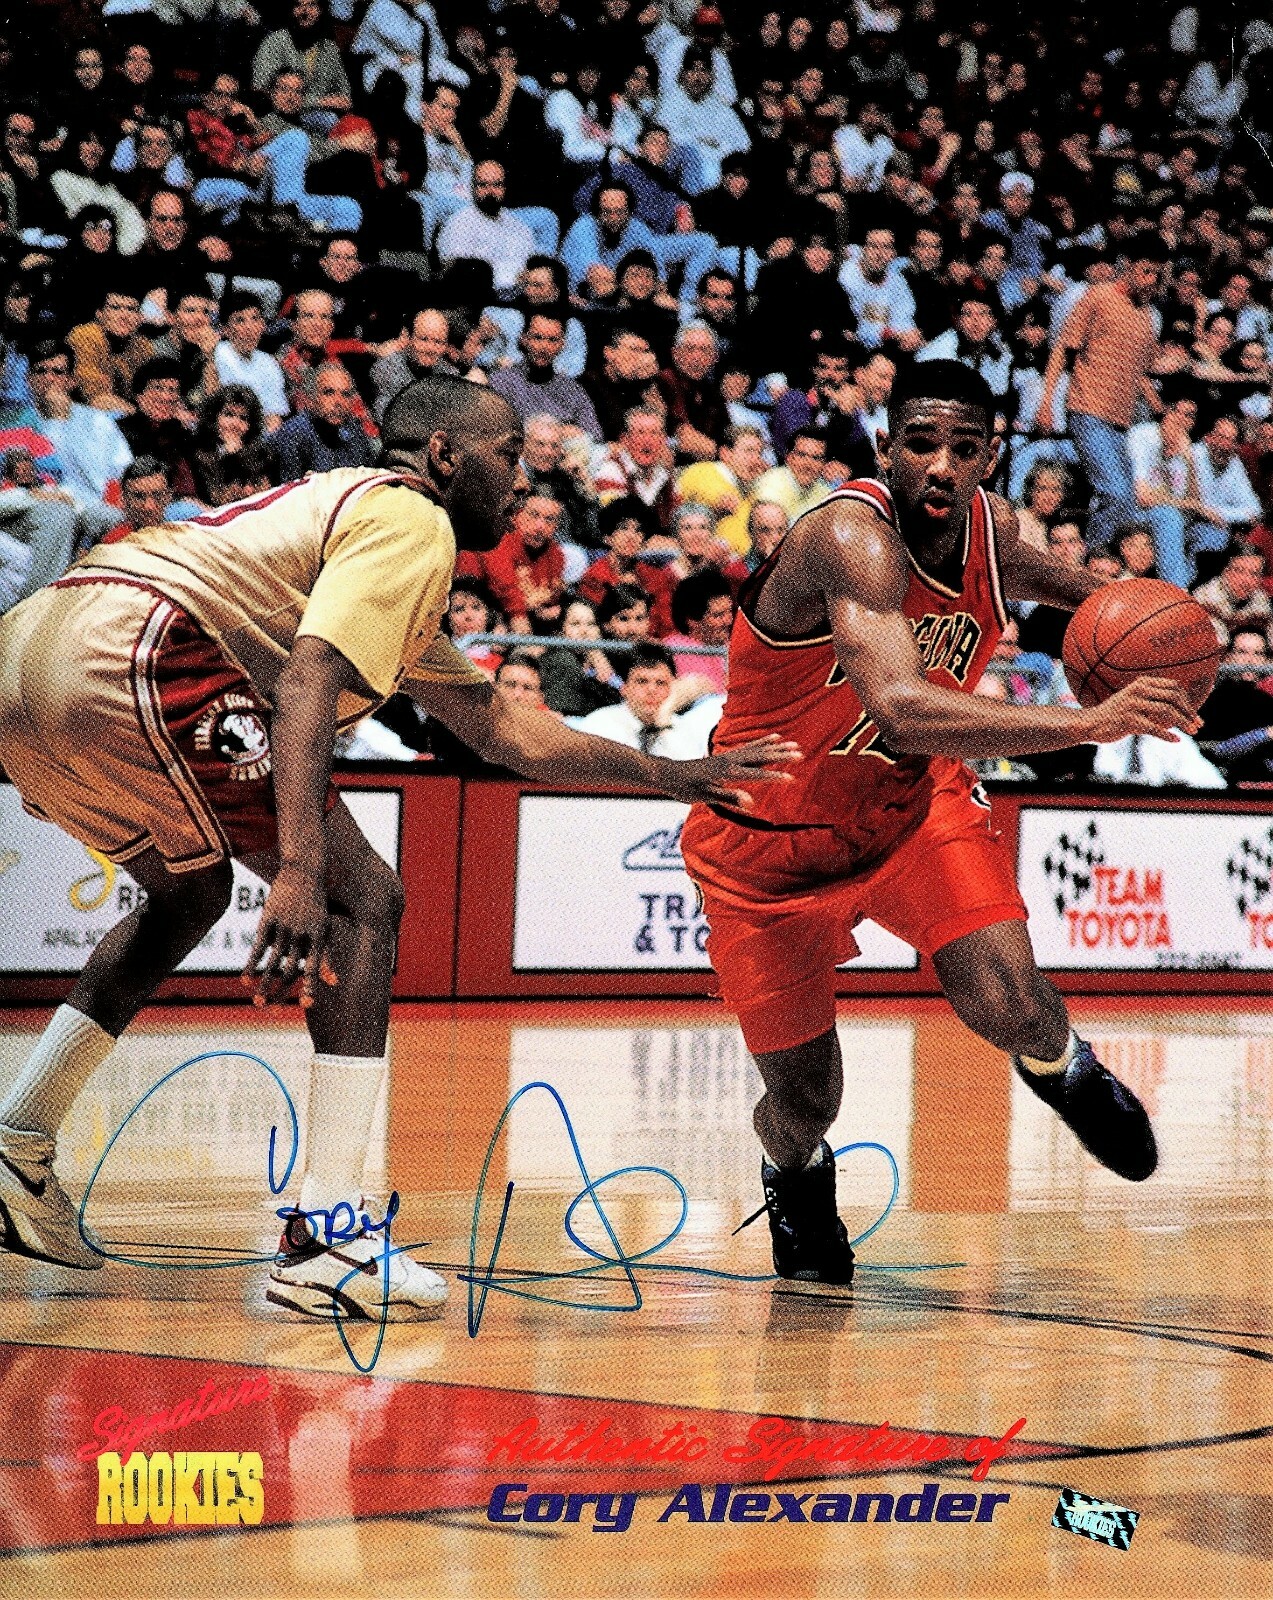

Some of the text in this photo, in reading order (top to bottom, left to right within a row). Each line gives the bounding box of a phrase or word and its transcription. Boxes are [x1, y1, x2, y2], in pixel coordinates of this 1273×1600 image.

[1093, 865, 1164, 906] TEAM
[634, 924, 655, 952] &
[1065, 910, 1172, 949] TOYOTA
